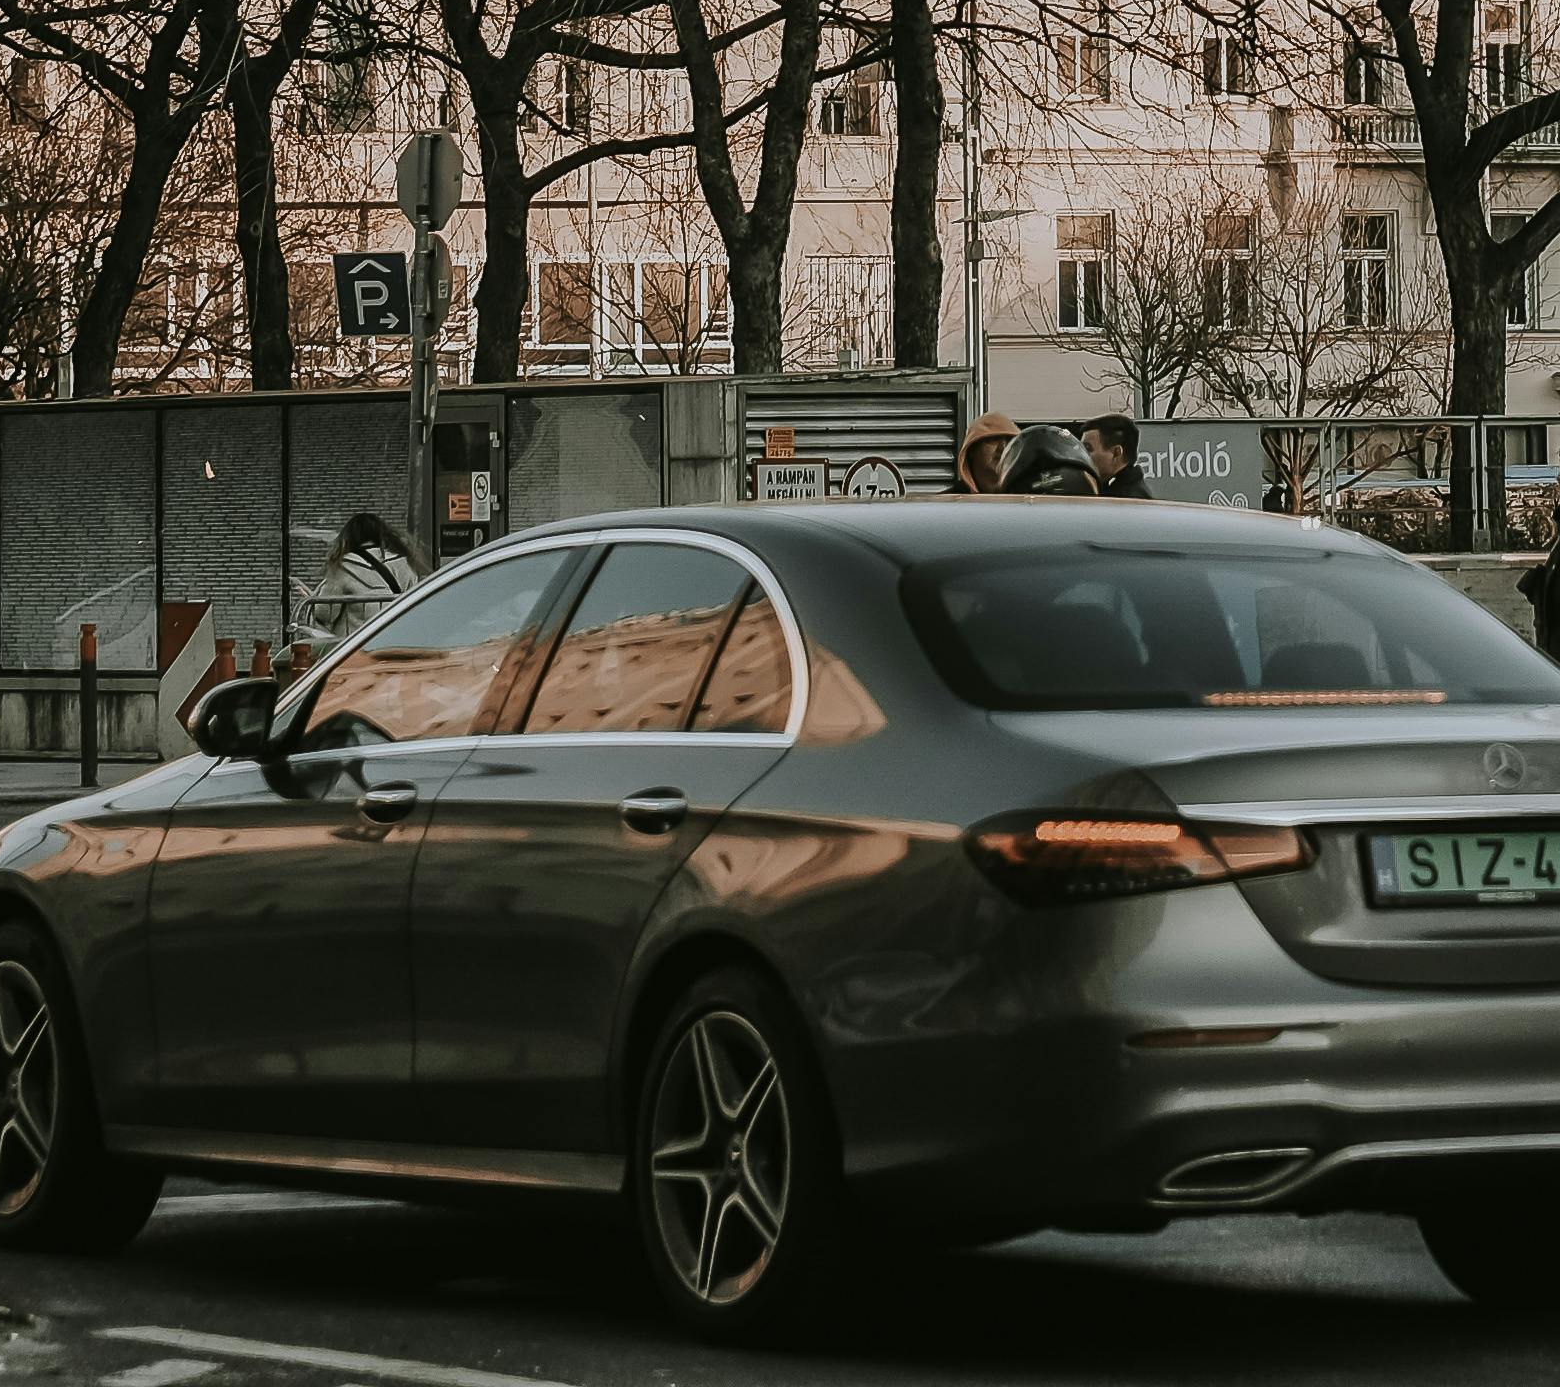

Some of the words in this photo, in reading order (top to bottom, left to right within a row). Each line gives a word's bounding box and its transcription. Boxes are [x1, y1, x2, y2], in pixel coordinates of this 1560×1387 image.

[354, 280, 389, 326] P
[766, 470, 775, 485] A
[775, 467, 816, 485] RÁMPÁN
[1136, 438, 1232, 479] arkoló
